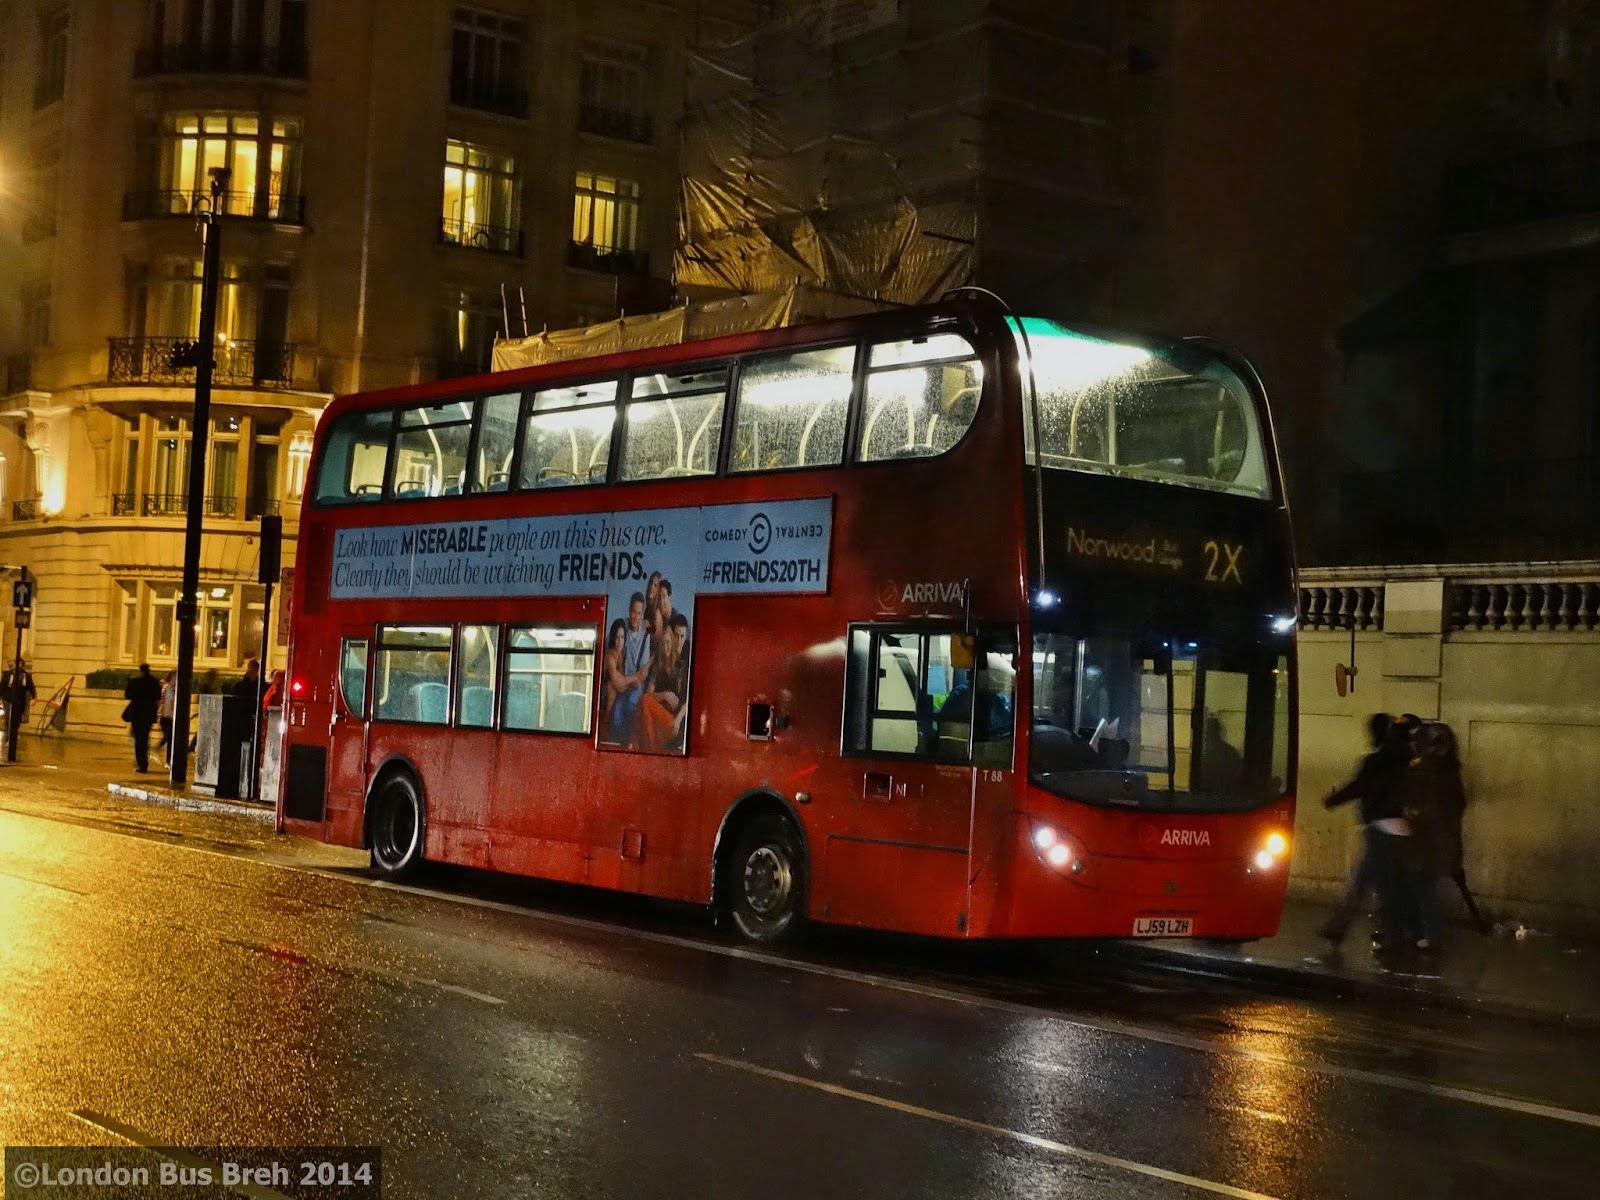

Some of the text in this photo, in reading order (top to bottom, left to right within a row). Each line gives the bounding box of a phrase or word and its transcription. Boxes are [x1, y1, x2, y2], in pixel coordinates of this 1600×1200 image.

[336, 518, 668, 559] Look how MISERABLE people on this bus are.
[705, 526, 748, 543] COMEDY
[775, 523, 823, 540] CENTRAL
[1066, 527, 1155, 563] Norwood
[335, 550, 648, 592] Clearly they should be watching FRIENDS.
[703, 558, 821, 584] #FRIENDS20TH
[1204, 540, 1244, 585] 2X
[901, 582, 962, 603] ARRIVA
[982, 769, 990, 782] T
[991, 770, 1003, 783] 88
[1160, 828, 1211, 846] ARRIVA
[1136, 919, 1190, 934] LJ59 LZH
